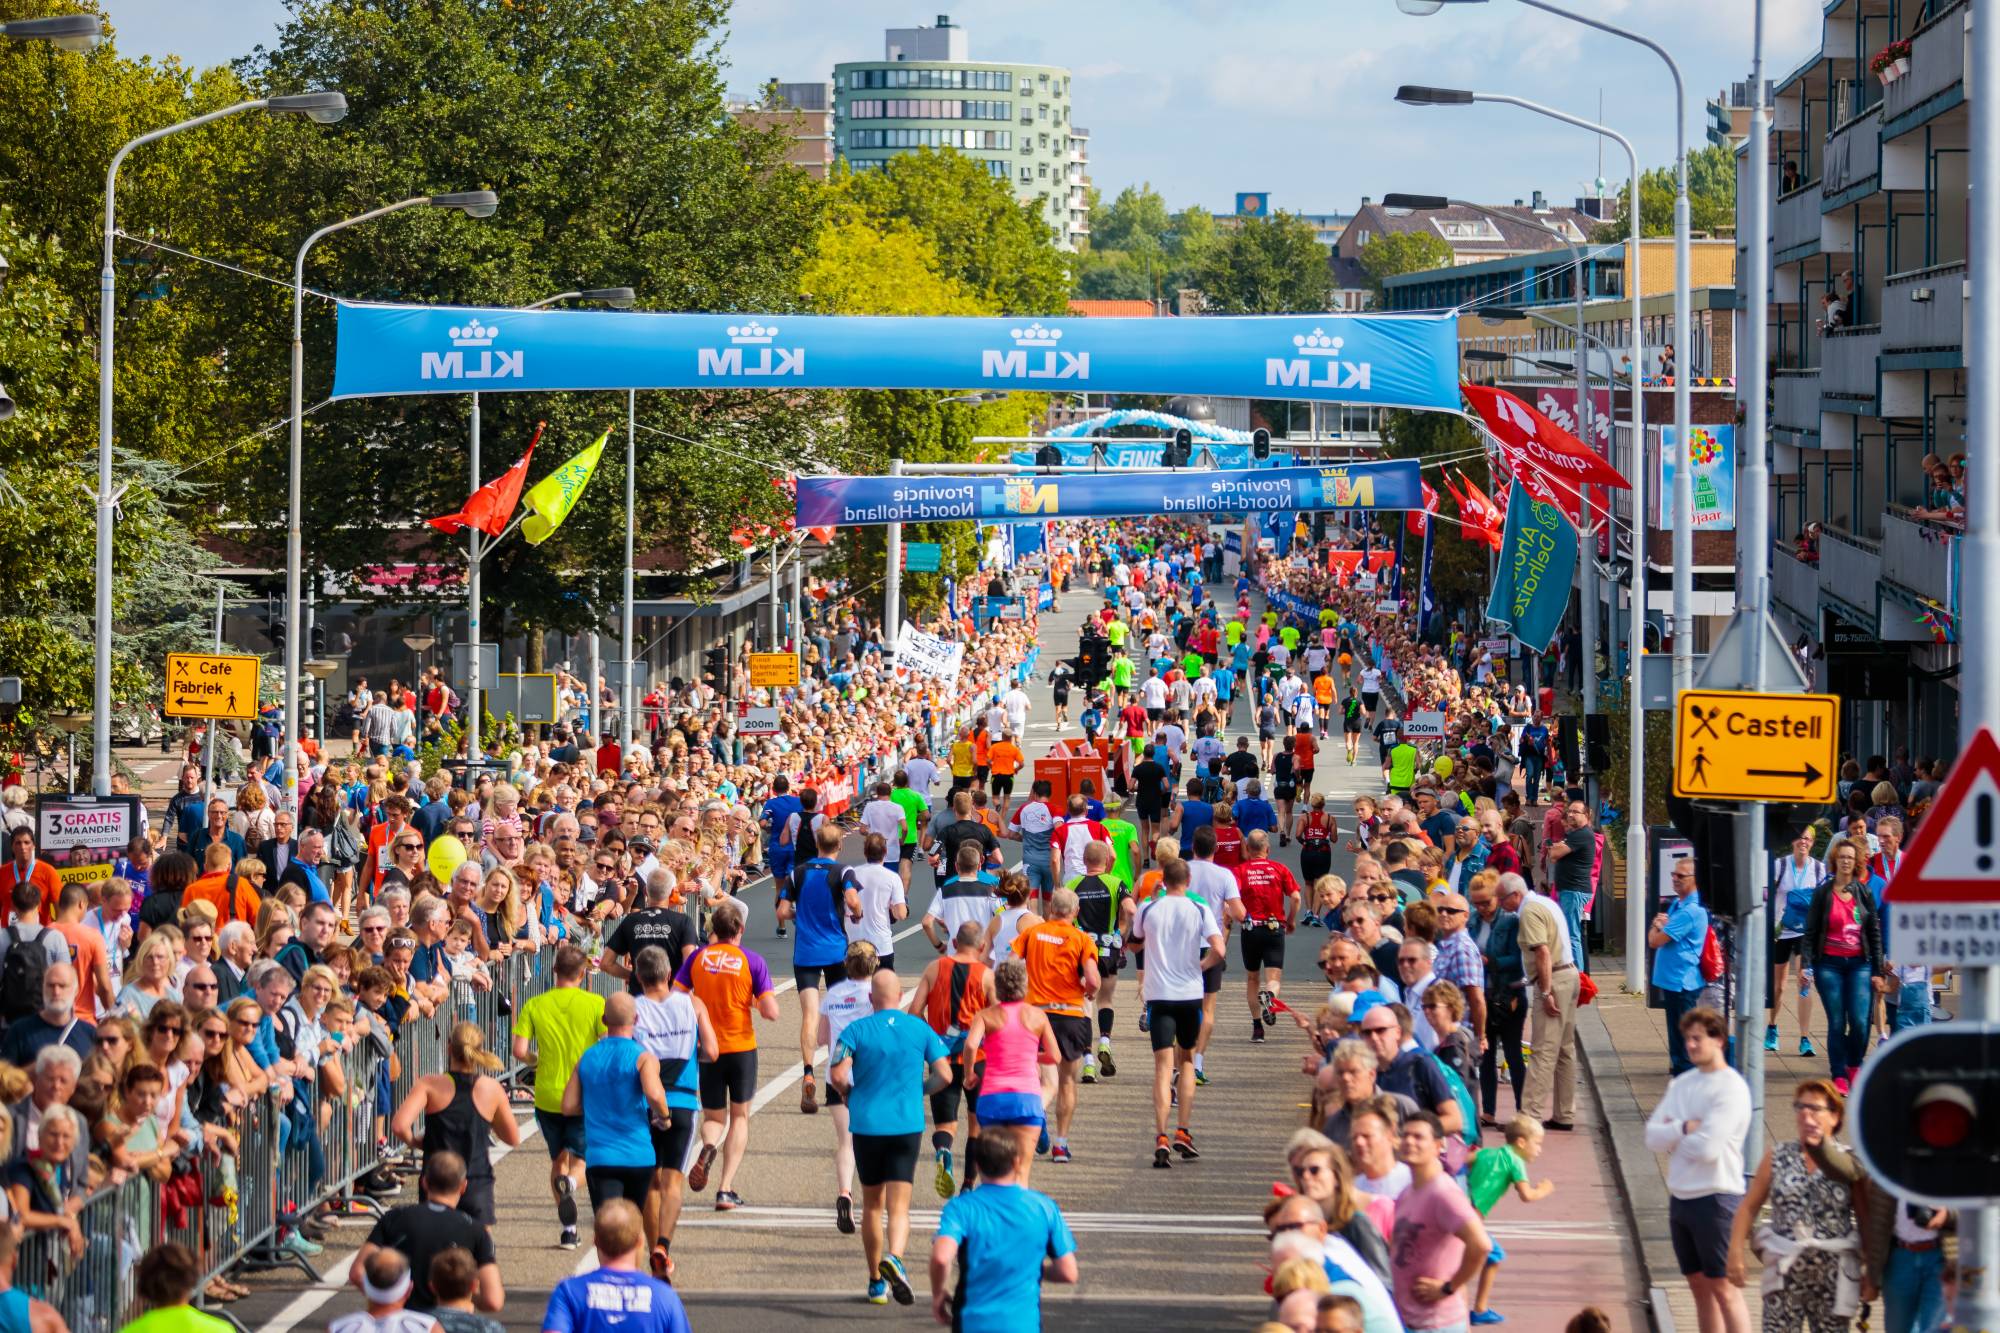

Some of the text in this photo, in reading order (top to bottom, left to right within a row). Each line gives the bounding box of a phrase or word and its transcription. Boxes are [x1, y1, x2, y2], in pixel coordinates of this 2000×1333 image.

[1117, 450, 1165, 468] FINIS
[199, 660, 232, 675] Café
[174, 681, 223, 695] Fabriek
[745, 721, 774, 729] 200m
[1408, 724, 1438, 732] 200m
[1726, 712, 1822, 739] Castell
[49, 811, 122, 836] 3 GRATIS
[61, 871, 98, 883] ARDIO
[1918, 935, 2000, 961] slagbo
